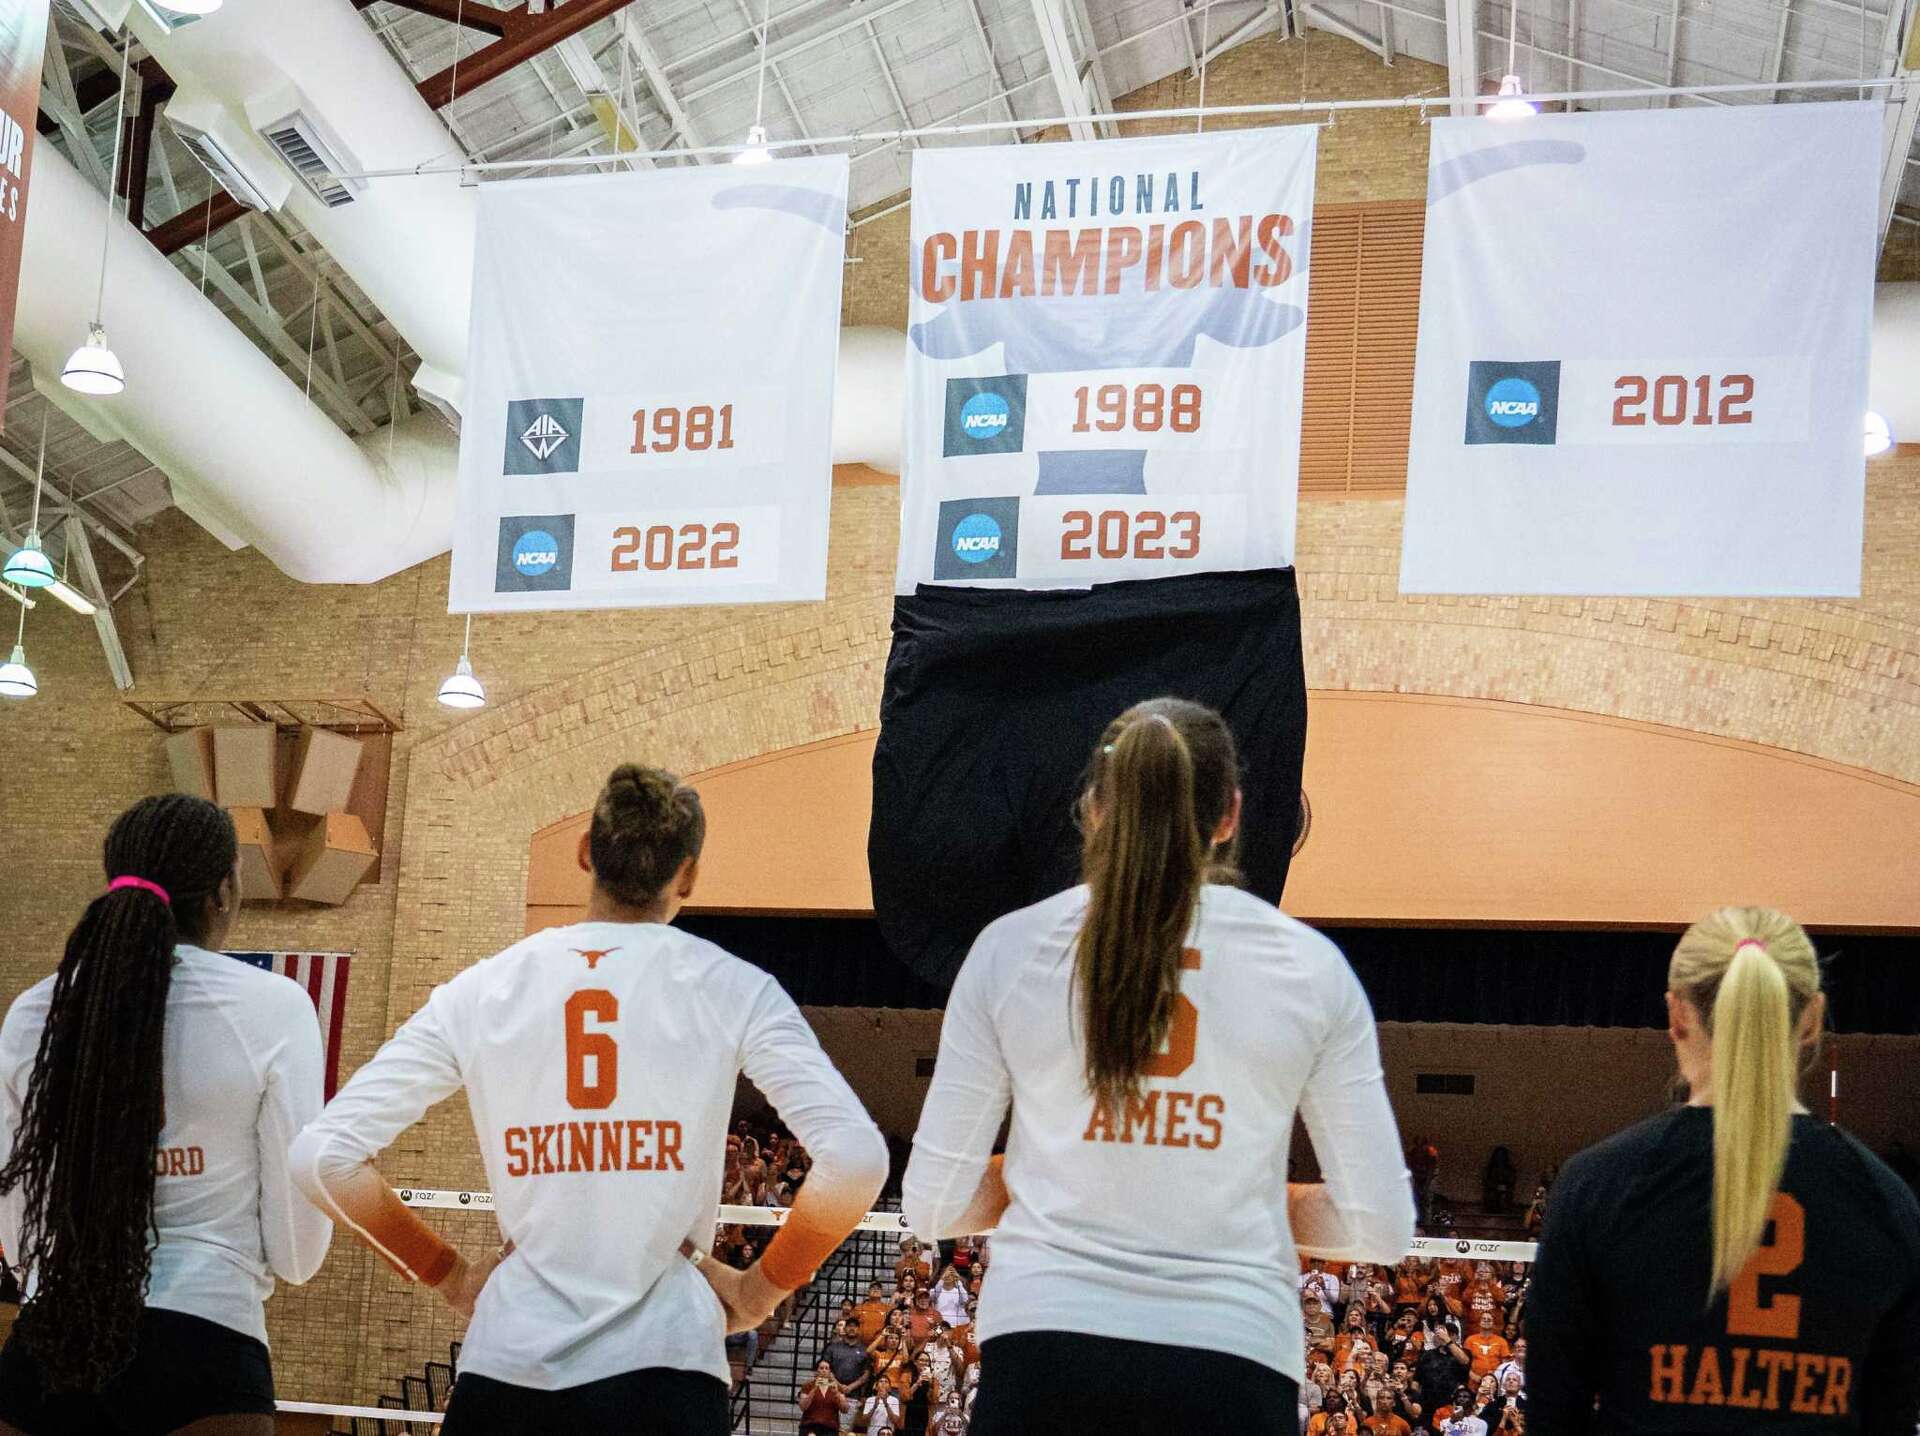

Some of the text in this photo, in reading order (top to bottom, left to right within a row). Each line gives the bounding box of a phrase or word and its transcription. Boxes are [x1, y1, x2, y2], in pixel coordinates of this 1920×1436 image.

[1013, 171, 1203, 220] NATIONAL
[922, 214, 1294, 303] CHAMPIONS
[965, 413, 1007, 429] NCAA
[1072, 383, 1202, 433] 1988
[1490, 401, 1537, 416] NCAA
[1612, 374, 1754, 426] 2012
[630, 404, 734, 454] 1981
[517, 551, 557, 567] NCAA
[611, 522, 740, 572] 2022
[956, 535, 999, 551] NCAA
[1060, 510, 1201, 560] 2023
[565, 989, 618, 1110] 6
[1083, 1089, 1225, 1150] AMES
[504, 1120, 684, 1177] SKINNER
[415, 1191, 437, 1201] razr
[1474, 1243, 1500, 1253] razr
[1726, 1191, 1806, 1339] 2
[1649, 1344, 1852, 1414] HALTER
